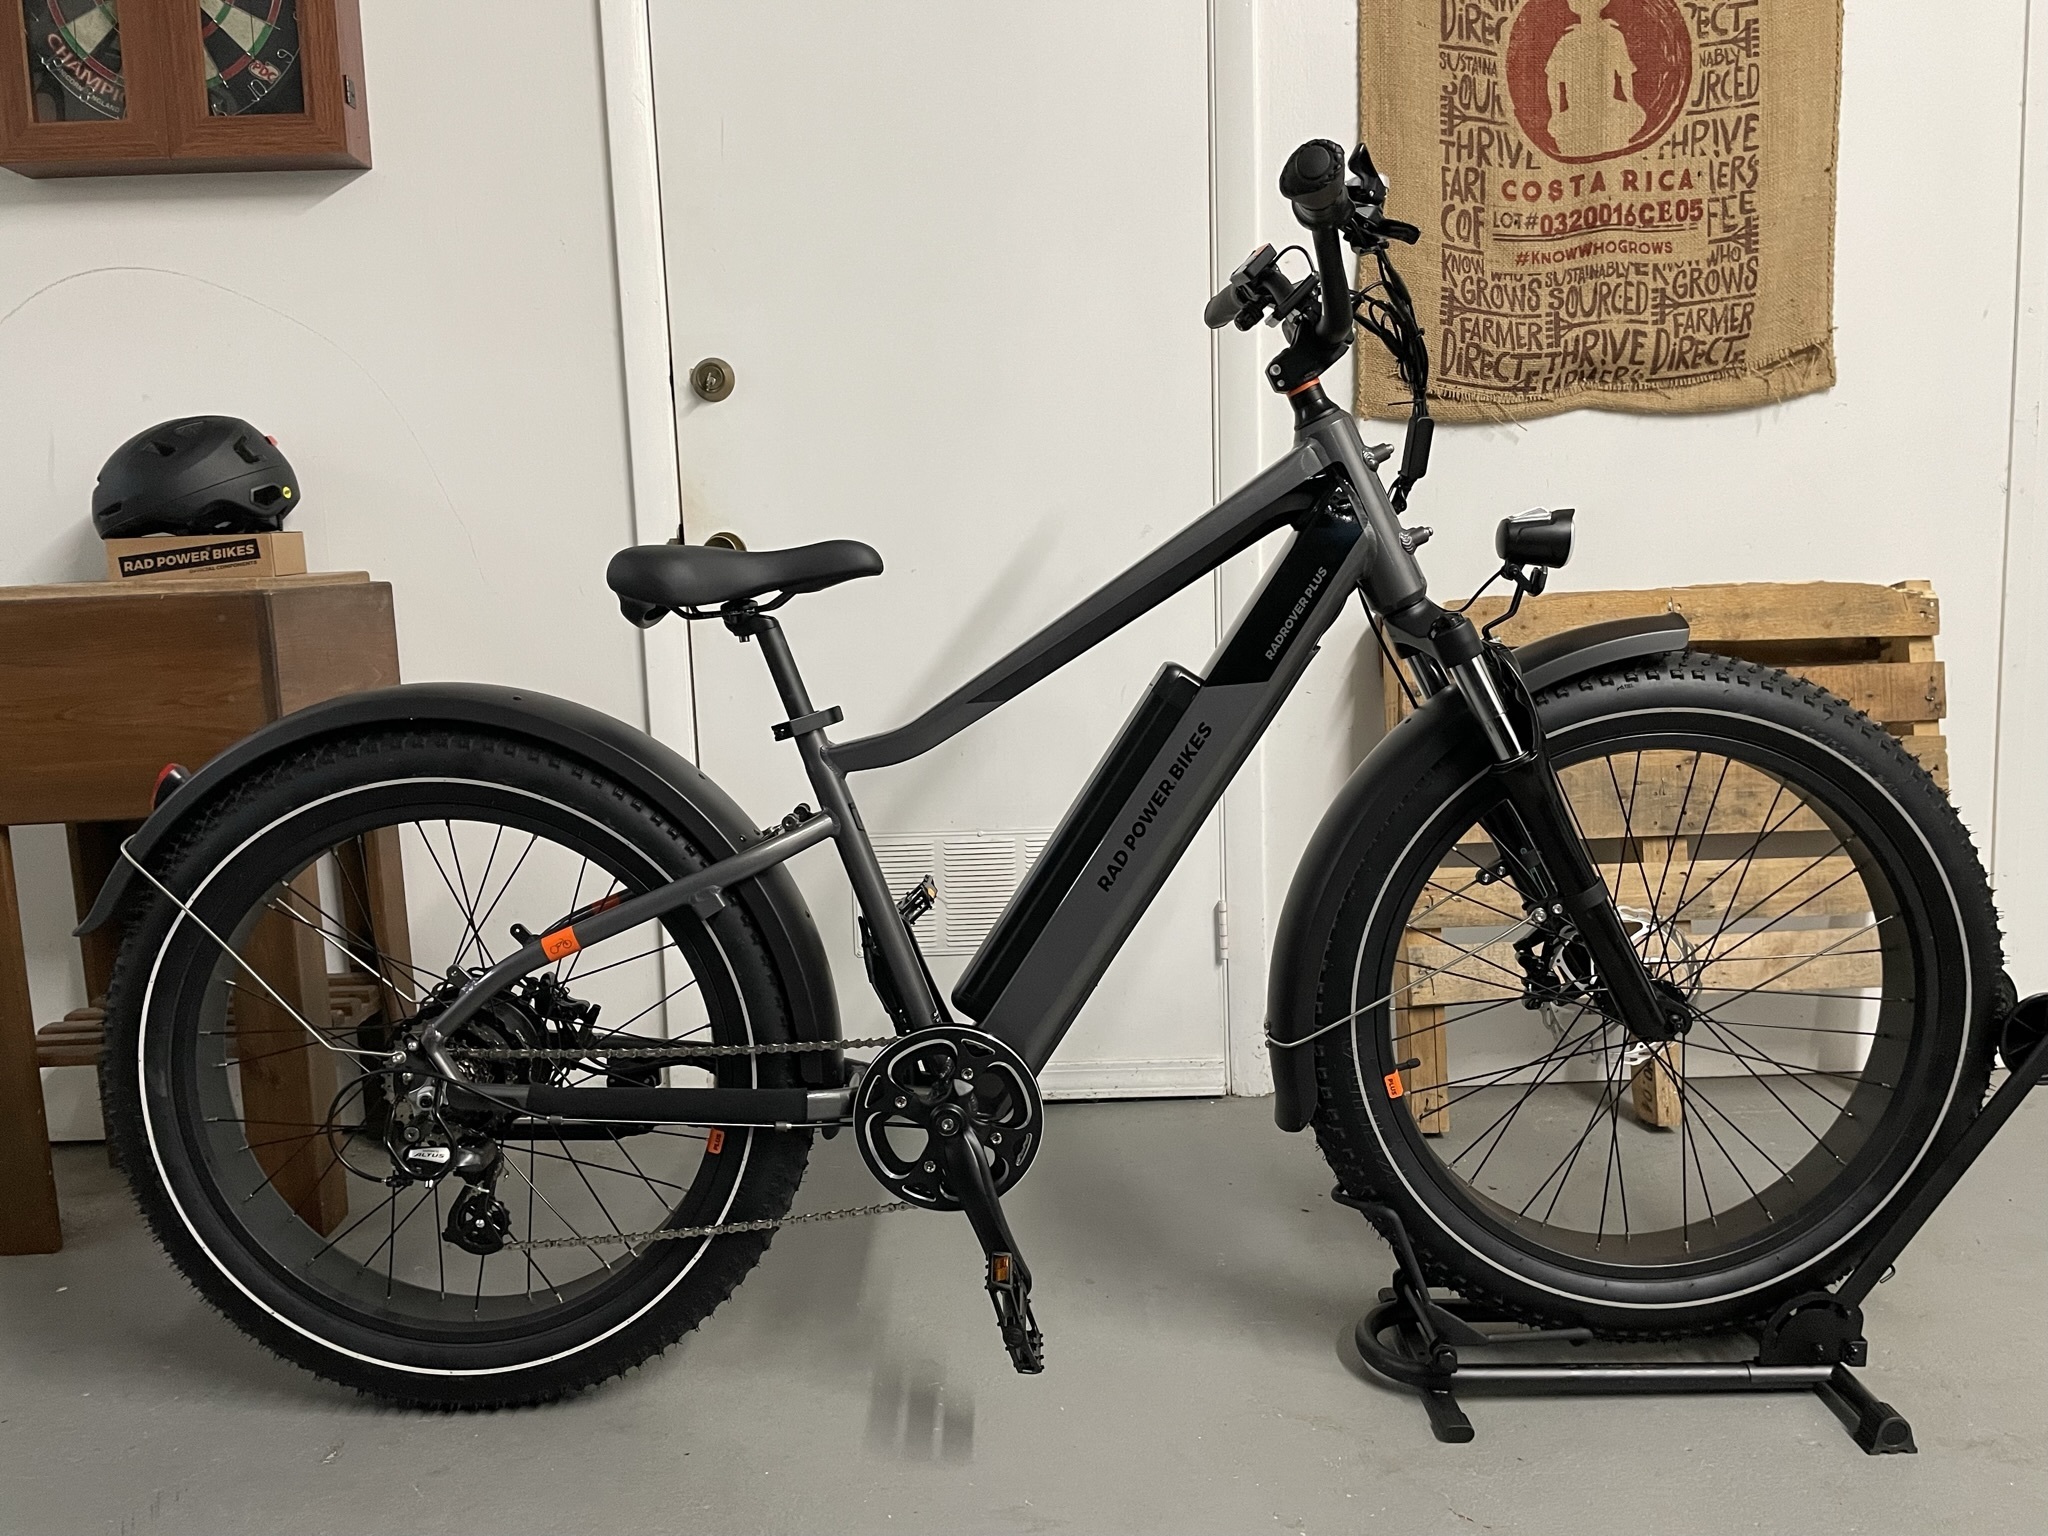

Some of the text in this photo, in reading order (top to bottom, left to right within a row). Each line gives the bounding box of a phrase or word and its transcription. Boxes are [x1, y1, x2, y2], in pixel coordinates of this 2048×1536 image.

[48, 33, 123, 102] CHAMPI
[252, 60, 278, 81] PDC
[1441, 166, 1486, 204] FAR
[1501, 168, 1694, 202] COSTA RICA
[1709, 154, 1759, 193] ERS
[1442, 249, 1484, 288] KNOW
[1515, 240, 1673, 266] #KNOWWHOGROWS
[1545, 261, 1630, 287] SUSTAINABLY
[1672, 255, 1758, 299] GROWS
[1461, 275, 1541, 312] GROWS
[1548, 281, 1648, 319] SOURCED
[1460, 316, 1543, 351] FARMER
[1673, 302, 1754, 338] FARMER
[123, 544, 255, 572] RAD POWER BIKES
[1265, 566, 1327, 660] RADROVER PLUS
[1096, 721, 1213, 893] RAD POWER BIKES
[1387, 1078, 1398, 1096] PLUS
[712, 1133, 722, 1151] PLUS
